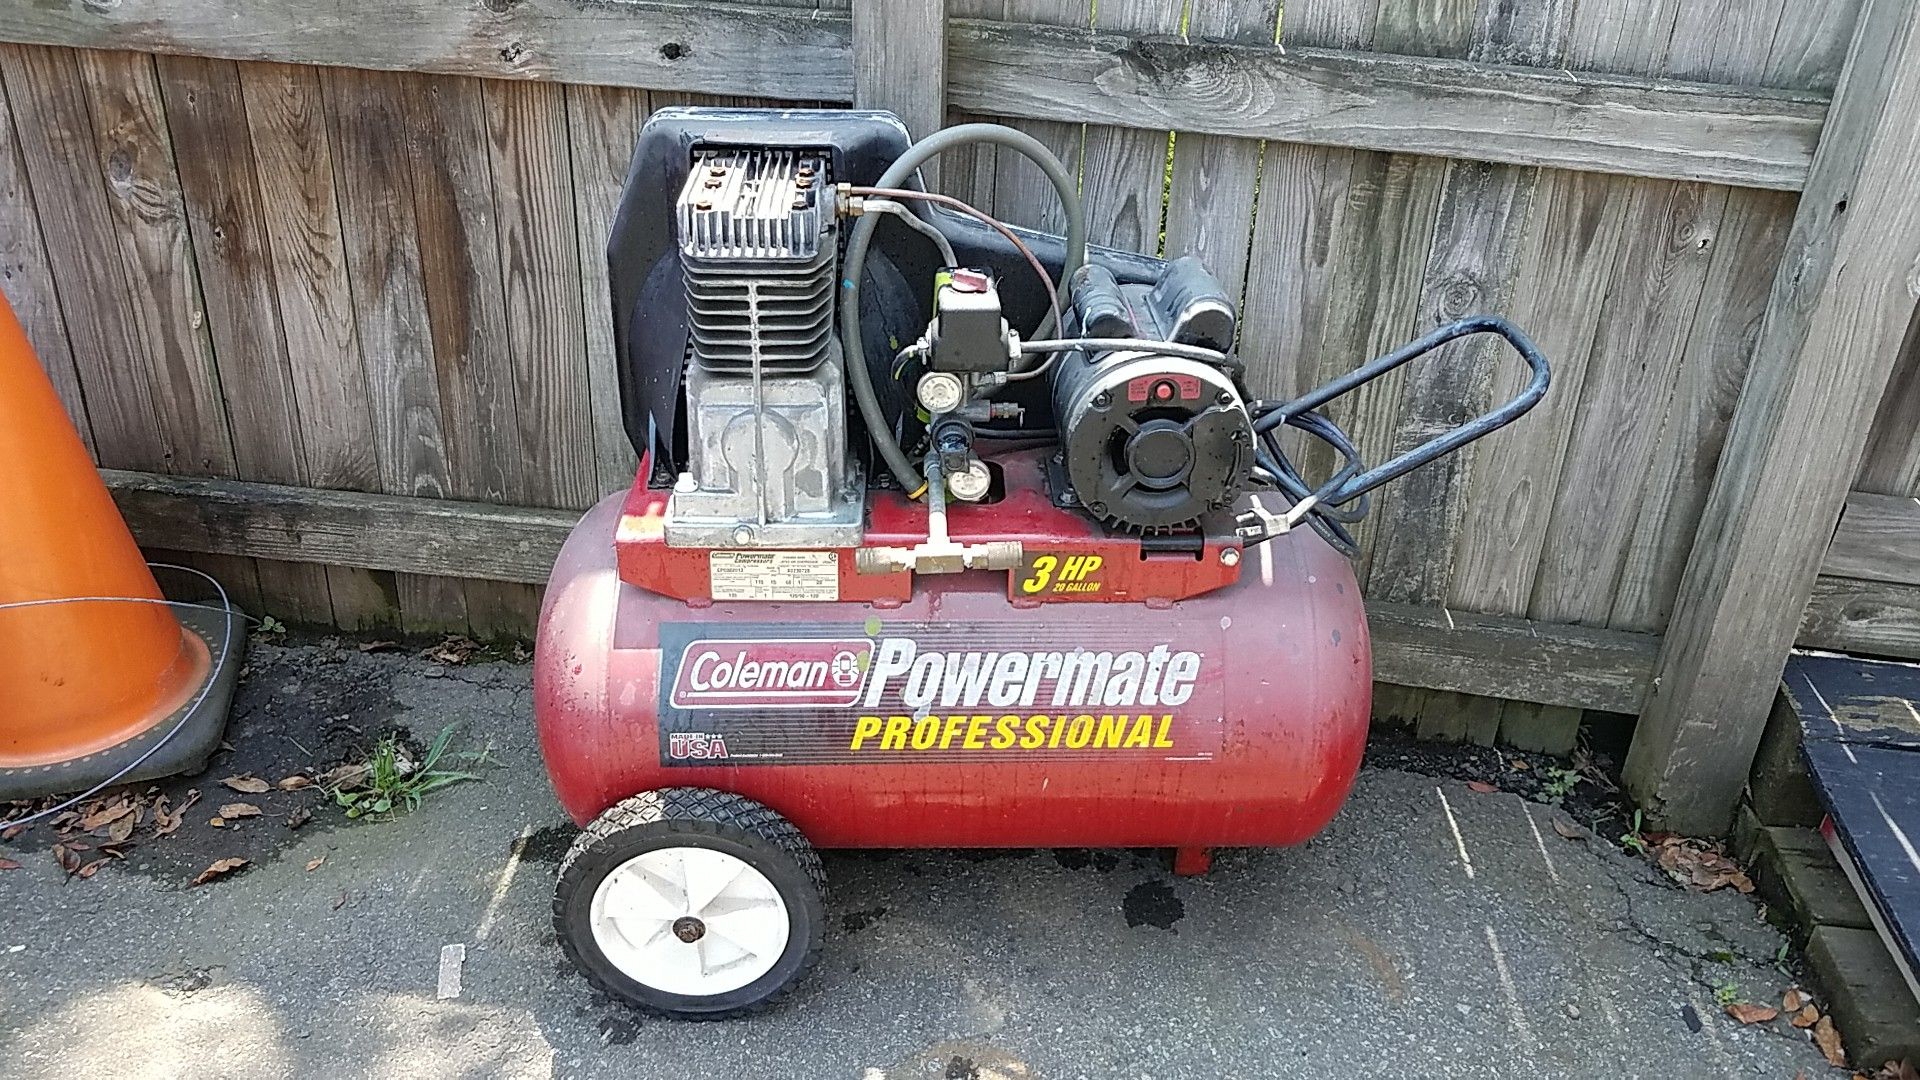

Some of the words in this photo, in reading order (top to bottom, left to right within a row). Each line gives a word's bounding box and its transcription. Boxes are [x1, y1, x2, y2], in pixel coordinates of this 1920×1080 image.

[1022, 555, 1058, 593] 3
[1057, 555, 1103, 581] HP
[1052, 583, 1066, 592] 20
[1066, 582, 1101, 592] GALLON
[690, 650, 829, 691] Coleman
[863, 637, 1200, 708] Powermate
[670, 739, 728, 759] USA
[850, 714, 1175, 750] PROFESSIONAL
